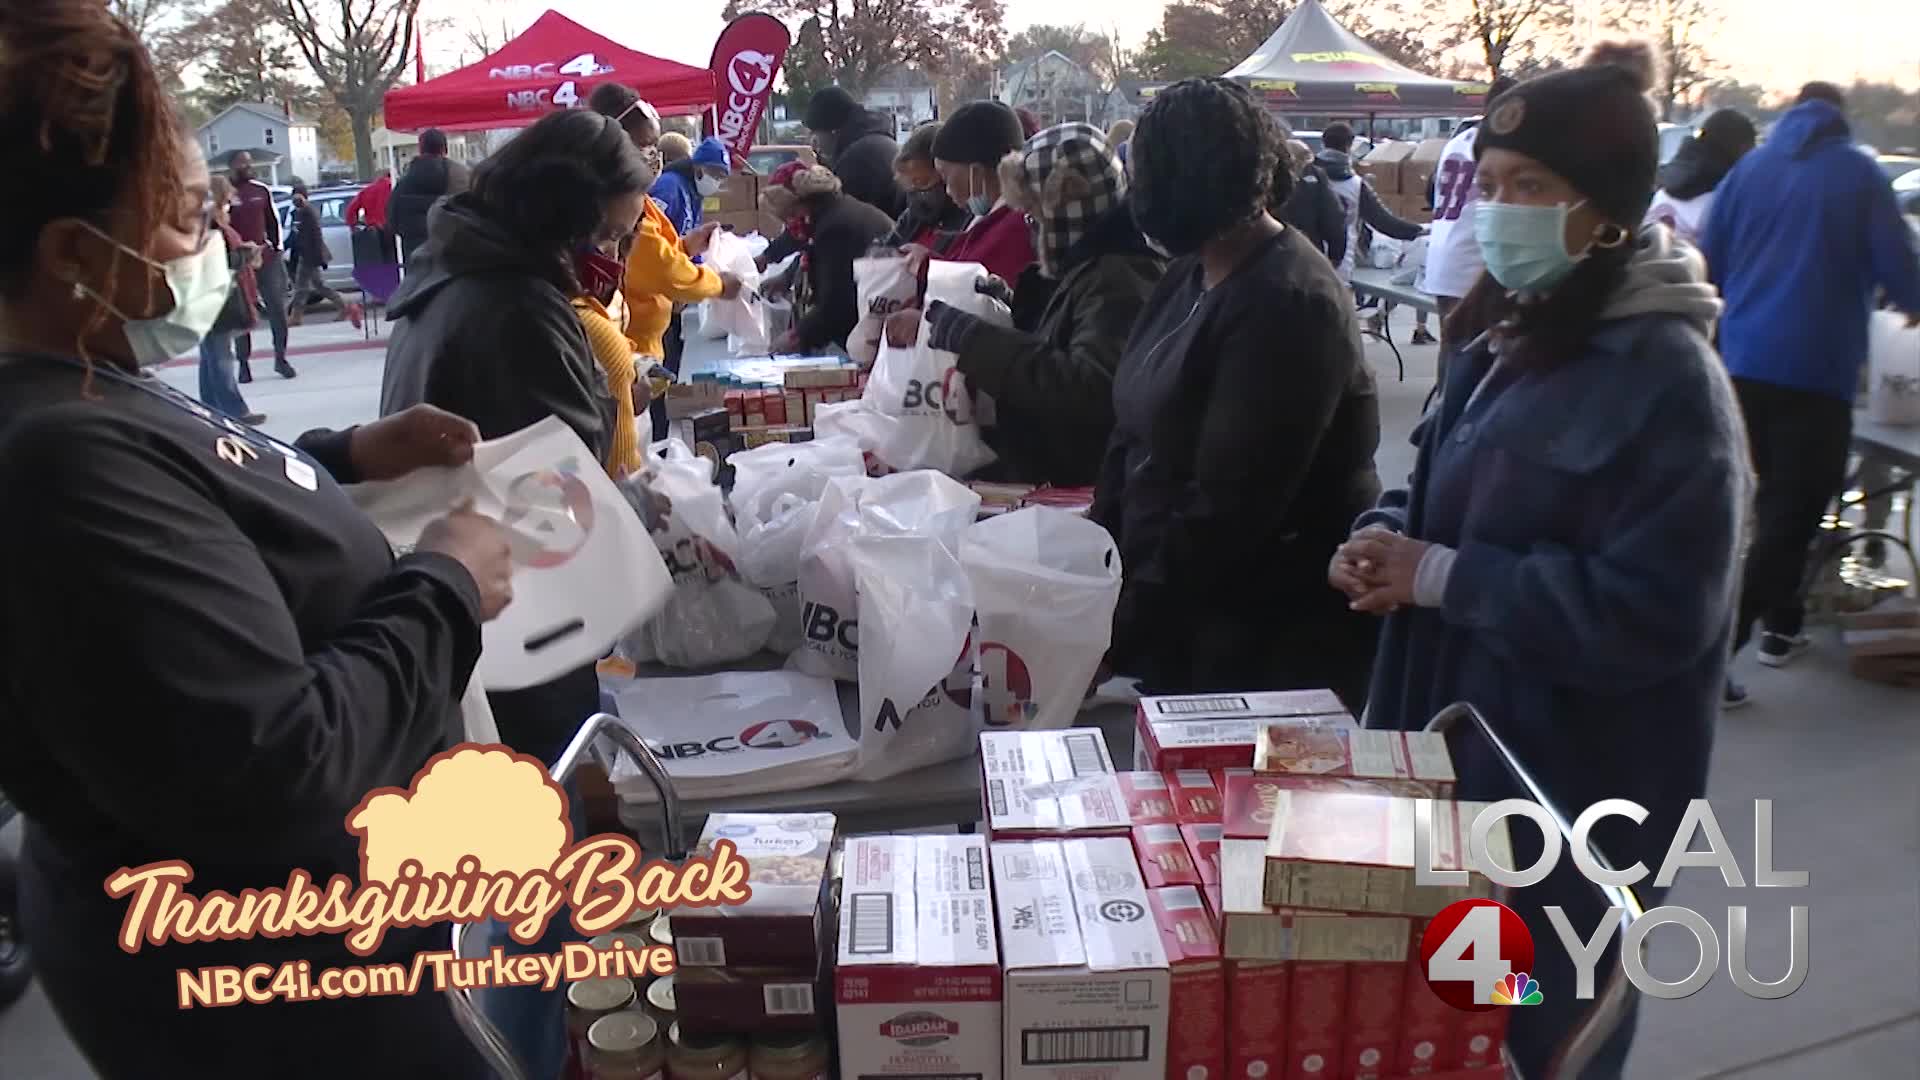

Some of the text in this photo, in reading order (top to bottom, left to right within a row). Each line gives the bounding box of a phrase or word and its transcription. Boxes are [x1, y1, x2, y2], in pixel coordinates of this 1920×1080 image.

[488, 53, 599, 80] NBC 4
[507, 81, 578, 108] NBC 4
[719, 91, 751, 148] NBC
[902, 379, 941, 410] BC
[650, 737, 740, 760] NBC
[753, 838, 801, 847] Turkey
[889, 1020, 948, 1037] IDAHOAN
